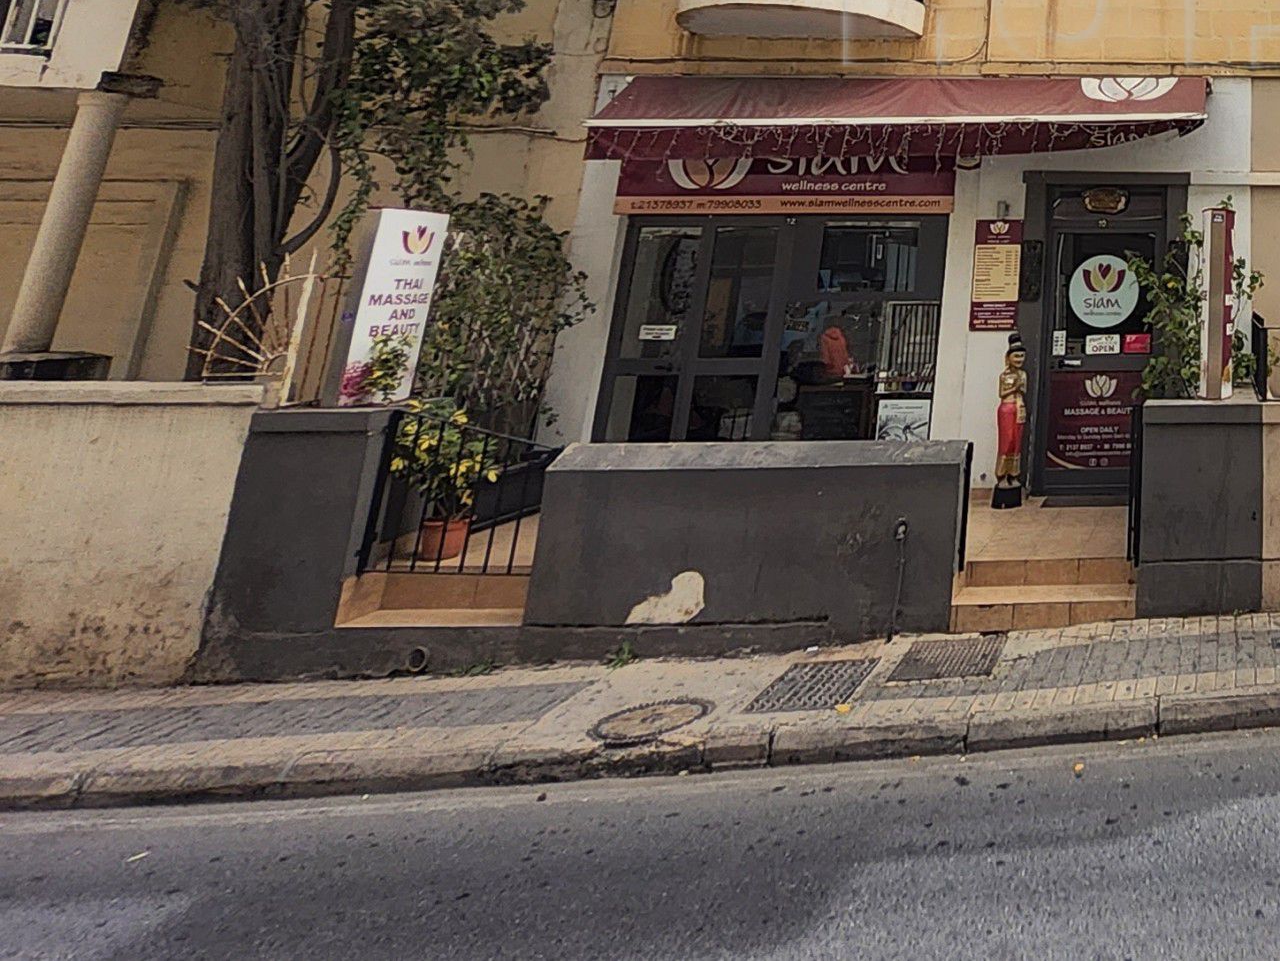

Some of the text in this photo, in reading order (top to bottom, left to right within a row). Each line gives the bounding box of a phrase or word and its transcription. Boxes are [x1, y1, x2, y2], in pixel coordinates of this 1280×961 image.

[781, 180, 887, 191] wellness centre
[779, 198, 941, 209] www.siamwellnesscentre.com
[394, 278, 424, 289] THAI
[368, 293, 429, 306] MASSAGE
[1083, 293, 1122, 309] siam
[388, 308, 416, 320] AND
[368, 322, 420, 337] BEAUTY
[1092, 344, 1115, 353] OPEN
[1064, 407, 1099, 415] MASSAGE
[1106, 407, 1133, 415] BEAUT
[1080, 426, 1099, 434] OPEN
